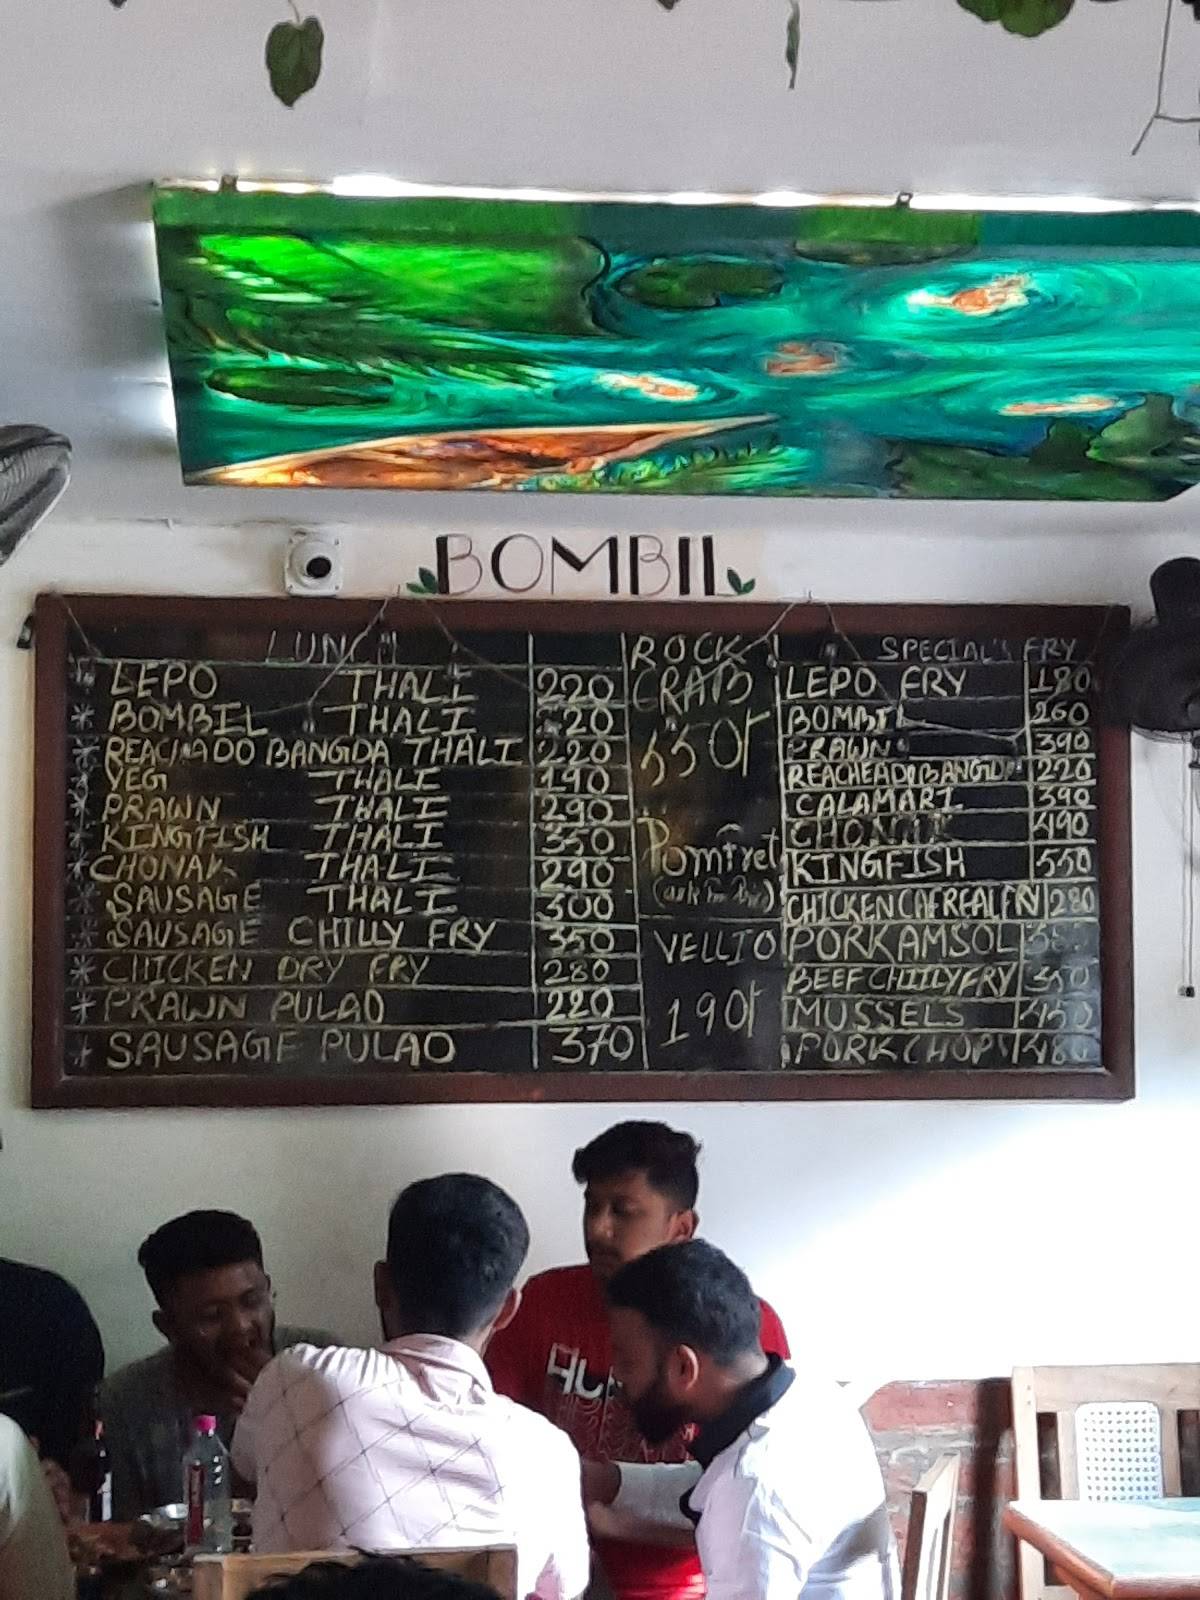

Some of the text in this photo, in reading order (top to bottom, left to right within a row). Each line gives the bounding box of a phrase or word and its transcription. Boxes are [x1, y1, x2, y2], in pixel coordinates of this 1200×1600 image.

[436, 534, 739, 597] BOMBIL
[631, 632, 747, 670] ROCK
[1024, 637, 1076, 662] FRY
[111, 661, 614, 704] LEPO THALI 220
[633, 657, 753, 715] CRAB
[786, 666, 1091, 699] LEPO FRY 180
[108, 700, 268, 736] BOMBIL
[323, 703, 477, 736] THALI
[1030, 702, 1089, 726] 260
[265, 738, 390, 769] BANGDA
[404, 734, 523, 765] THALI
[537, 739, 611, 766] 220
[1036, 731, 1089, 754] 390
[106, 764, 610, 794] VEG THALI 190
[1037, 758, 1091, 781] 220
[102, 794, 613, 823] PRAWN THALI 290
[796, 786, 1090, 817] CALAMARI 390
[102, 824, 270, 851] KINGFISH
[313, 822, 444, 850] THALI
[1033, 810, 1088, 839] 490
[90, 852, 614, 889] CHONAK THALI 290
[792, 848, 1091, 886] KINGFISH 550
[106, 882, 261, 918] SAUSAGE
[306, 883, 458, 915] THALI
[787, 891, 894, 924] CHICKEN
[1050, 887, 1095, 916] 280
[107, 917, 261, 948] SAUSAGE
[288, 916, 404, 949] CHILLY
[428, 917, 496, 951] FRY
[789, 924, 890, 962] PORK
[897, 923, 1018, 961] AMSOL
[103, 953, 610, 985] CHICKEN DRY FRY 280
[787, 967, 864, 994] BEEF
[957, 962, 1017, 996] FRY
[104, 987, 614, 1023] PRAWN PULAO 220
[793, 998, 965, 1032] MUSSELS
[321, 1028, 455, 1066] PULAO
[549, 1024, 634, 1066] 370
[795, 1033, 897, 1064] PORK
